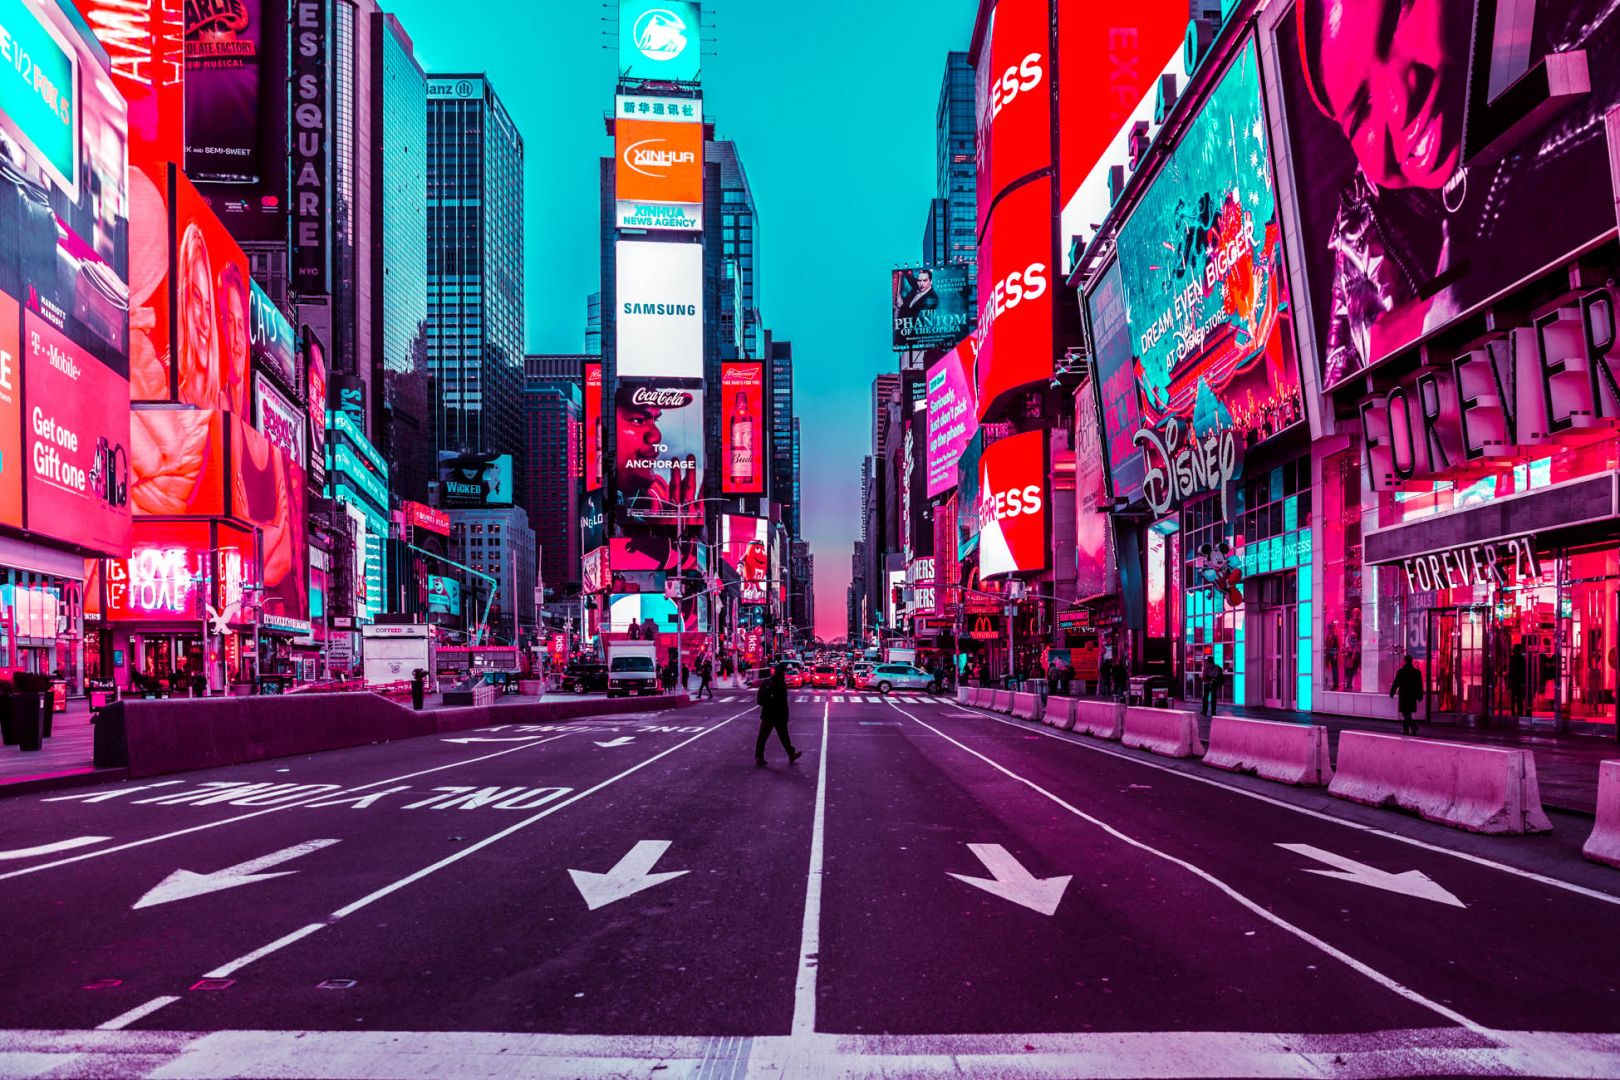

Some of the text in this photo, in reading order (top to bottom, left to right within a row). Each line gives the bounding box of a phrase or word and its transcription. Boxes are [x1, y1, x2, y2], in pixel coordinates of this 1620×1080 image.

[216, 39, 252, 54] FACTORY
[203, 59, 244, 69] MUSICAL
[1108, 27, 1139, 121] EXP
[34, 63, 59, 116] FOX
[60, 95, 69, 126] 5
[623, 101, 694, 117] 新华通讯社
[204, 146, 252, 157] SEMI-SWEET
[634, 149, 695, 166] XINHUA
[295, 75, 323, 247] SQUARE
[634, 204, 686, 219] XINHUA
[623, 216, 697, 228] NEWS AGENCY
[299, 267, 319, 276] NYC
[1174, 277, 1204, 322] EVEN
[1205, 223, 1261, 288] BIGGER
[623, 302, 696, 316] SAMSUNG
[921, 309, 937, 318] THE
[249, 290, 278, 347] CATS
[894, 313, 968, 331] PHANTOM
[900, 324, 961, 336] OF THE OPERA
[1166, 351, 1176, 372] AT
[1359, 287, 1620, 493] FOREVER
[930, 387, 956, 415] Seriously,
[929, 396, 967, 438] just don't pick
[33, 406, 78, 453] Get one
[652, 443, 668, 453] TO
[930, 438, 938, 453] up
[937, 432, 947, 447] the
[33, 441, 86, 492] Gift one
[625, 459, 695, 469] ANCHORAGE
[731, 452, 753, 464] Bud
[446, 481, 481, 494] WICKED
[1404, 536, 1539, 594] FOREVER 21
[1411, 593, 1433, 609] DEALS
[555, 635, 564, 653] tkts
[748, 634, 758, 652] tkts
